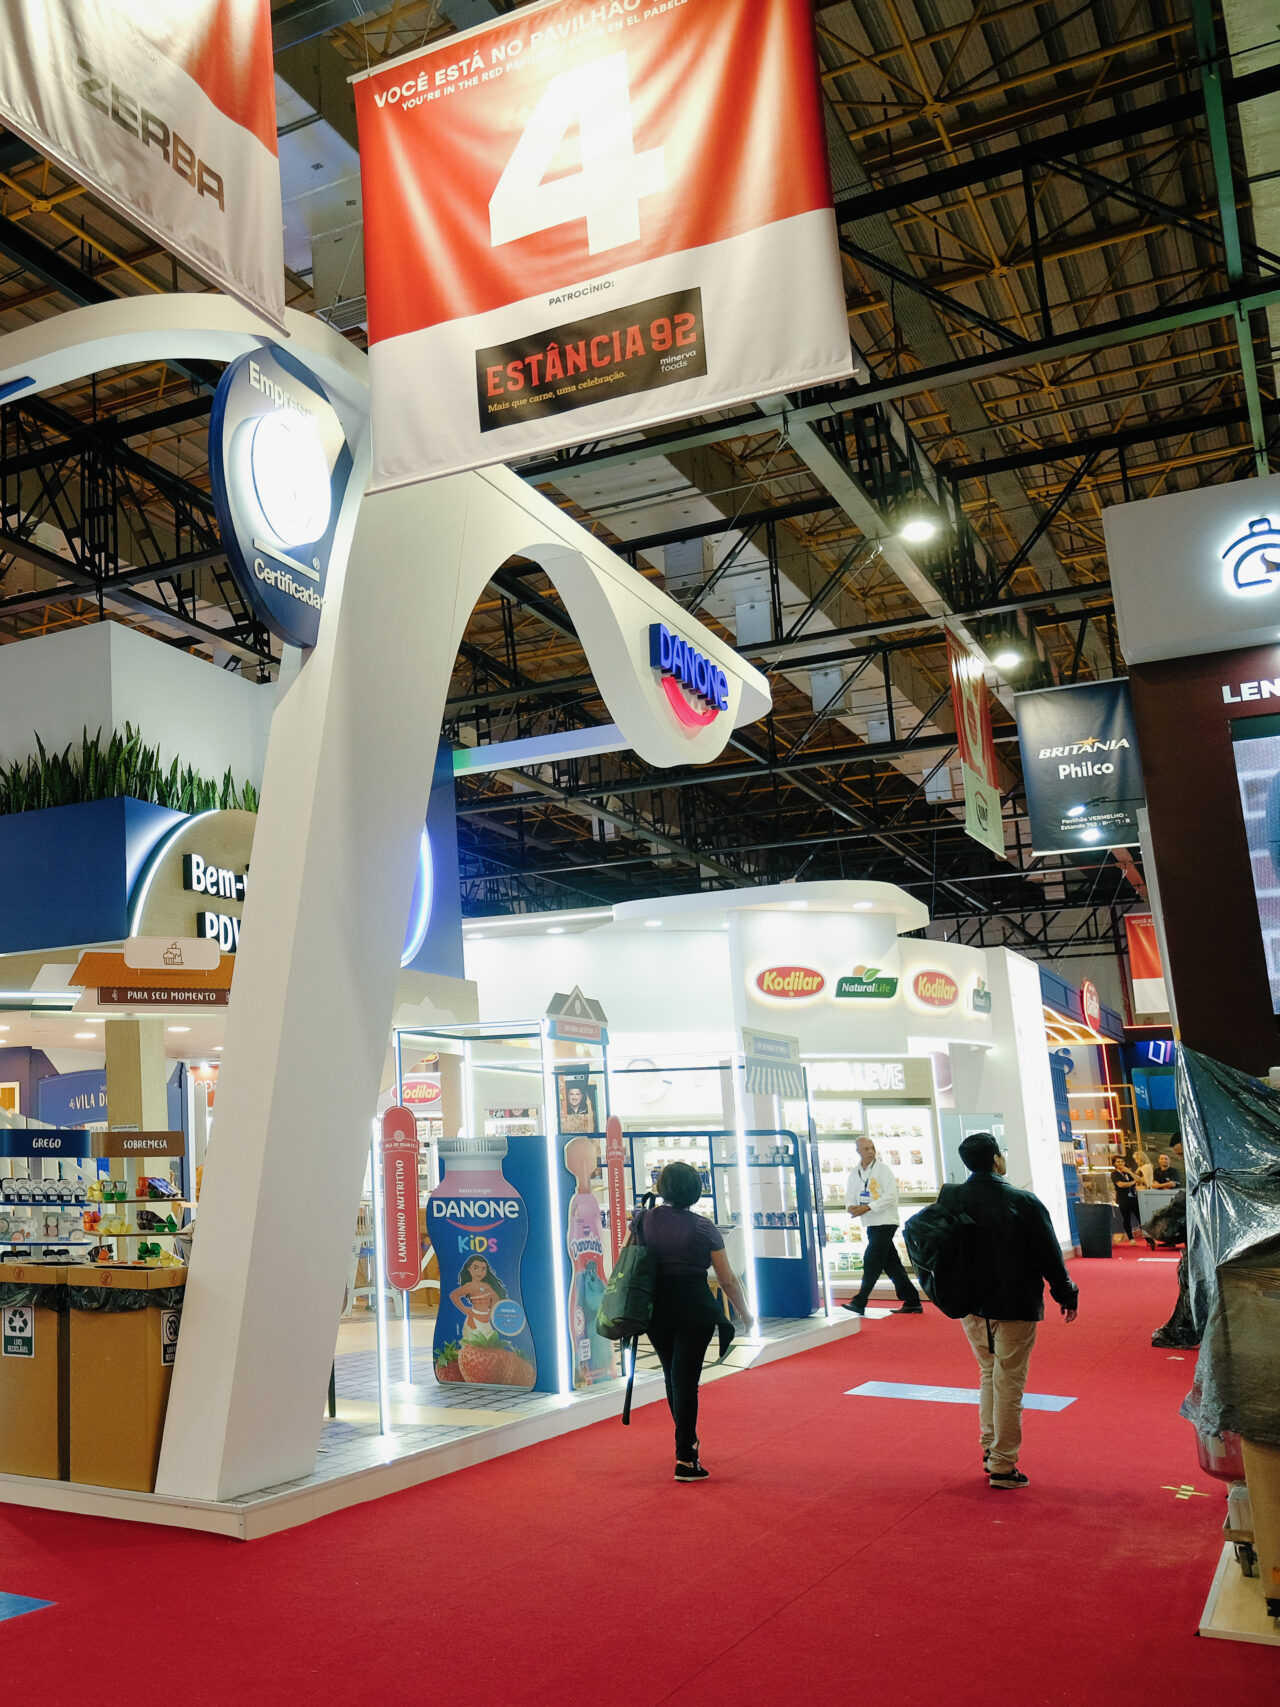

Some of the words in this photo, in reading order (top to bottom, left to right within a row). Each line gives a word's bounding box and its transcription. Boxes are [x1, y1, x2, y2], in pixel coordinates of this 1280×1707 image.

[607, 21, 624, 33] EN
[626, 15, 641, 26] EL
[374, 72, 429, 108] VOCÊ
[435, 50, 485, 87] ESTÁ
[491, 38, 524, 66] NO
[530, 0, 642, 49] PAVILHÃO
[401, 91, 441, 111] YOU'RE
[443, 85, 455, 96] IN
[458, 76, 480, 91] THE
[481, 67, 504, 83] RED
[76, 55, 225, 213] ZERBA
[489, 50, 667, 257] 4
[548, 280, 615, 307] PATROCÍNIO:
[486, 324, 647, 398] ESTÂNCIA
[649, 311, 698, 352] 92
[660, 349, 697, 366] minerva
[660, 358, 688, 373] foods
[487, 402, 510, 413] Mais
[511, 397, 528, 411] que
[529, 390, 556, 404] carne,
[556, 384, 577, 396] uma
[577, 370, 627, 391] celebração.
[254, 557, 322, 611] Certificada
[1058, 761, 1115, 780] Philco
[1088, 812, 1124, 822] VERMELHO
[762, 971, 823, 992] Kodilar
[841, 981, 892, 994] NaturalLife
[917, 975, 957, 1000] Kodilar
[127, 991, 149, 1000] PARA
[151, 991, 168, 1001] SEU
[170, 991, 217, 1001] MOMENTO
[75, 1093, 96, 1109] VILA
[32, 1137, 62, 1149] GREGO
[123, 1139, 168, 1149] SOBREMESA
[395, 1159, 406, 1210] NUTRITIVO
[398, 1212, 407, 1263] LANCHINHO
